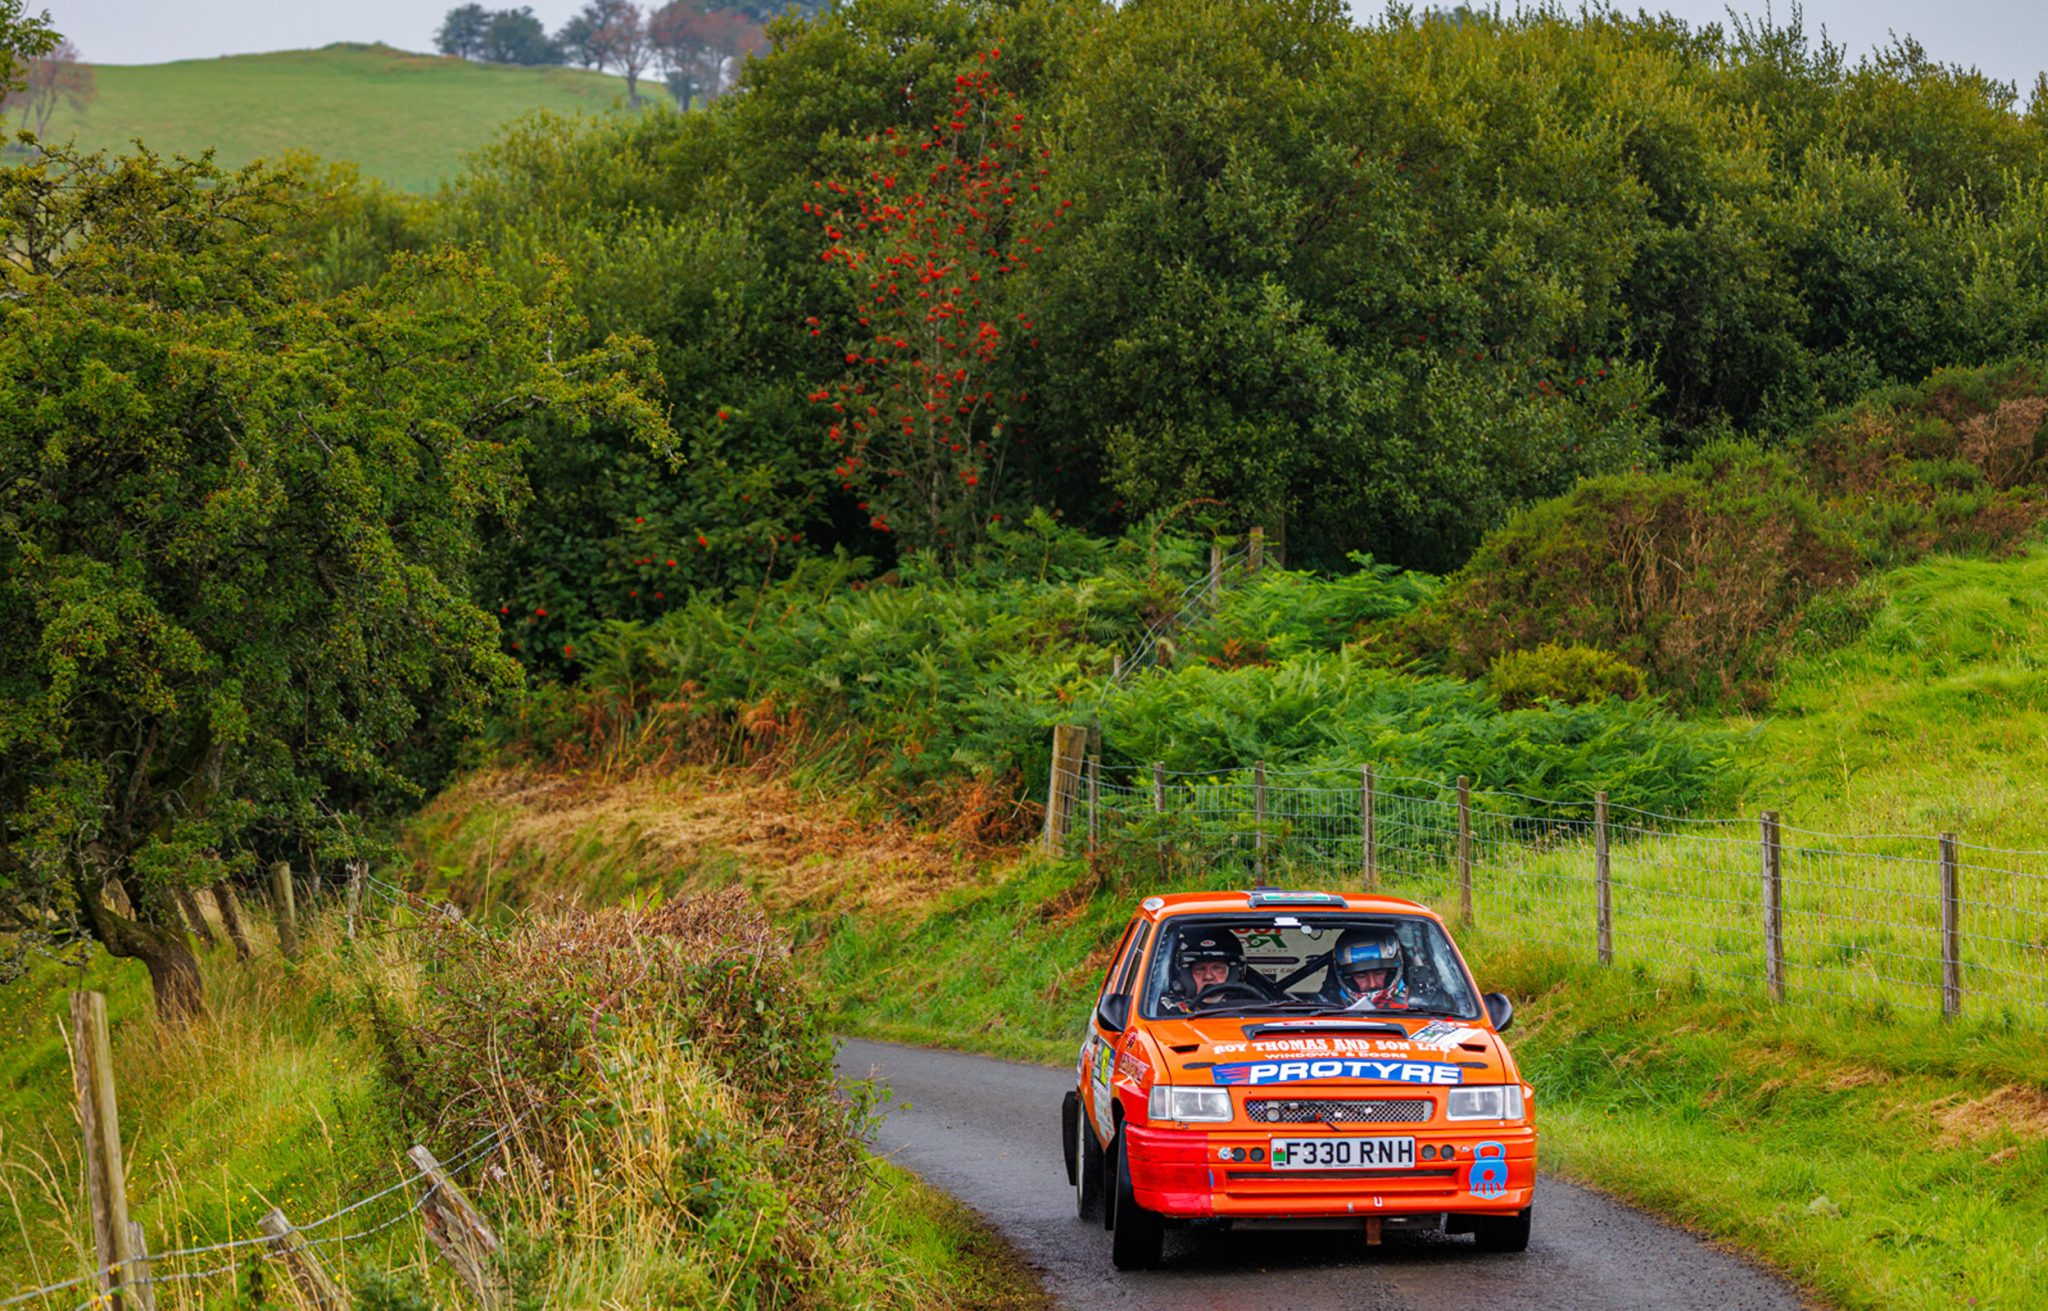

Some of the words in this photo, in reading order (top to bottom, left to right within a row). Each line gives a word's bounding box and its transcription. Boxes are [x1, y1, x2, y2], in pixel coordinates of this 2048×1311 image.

[1213, 1043, 1248, 1055] ROY
[1252, 1038, 1328, 1052] THOMAS
[1333, 1038, 1370, 1051] AND
[1378, 1040, 1411, 1051] SON
[1265, 1051, 1339, 1059] WINDOWS
[1359, 1051, 1408, 1059] DOORS
[1248, 1061, 1461, 1085] PROTYRE
[1285, 1141, 1351, 1164] F330
[1360, 1140, 1413, 1164] RNH
